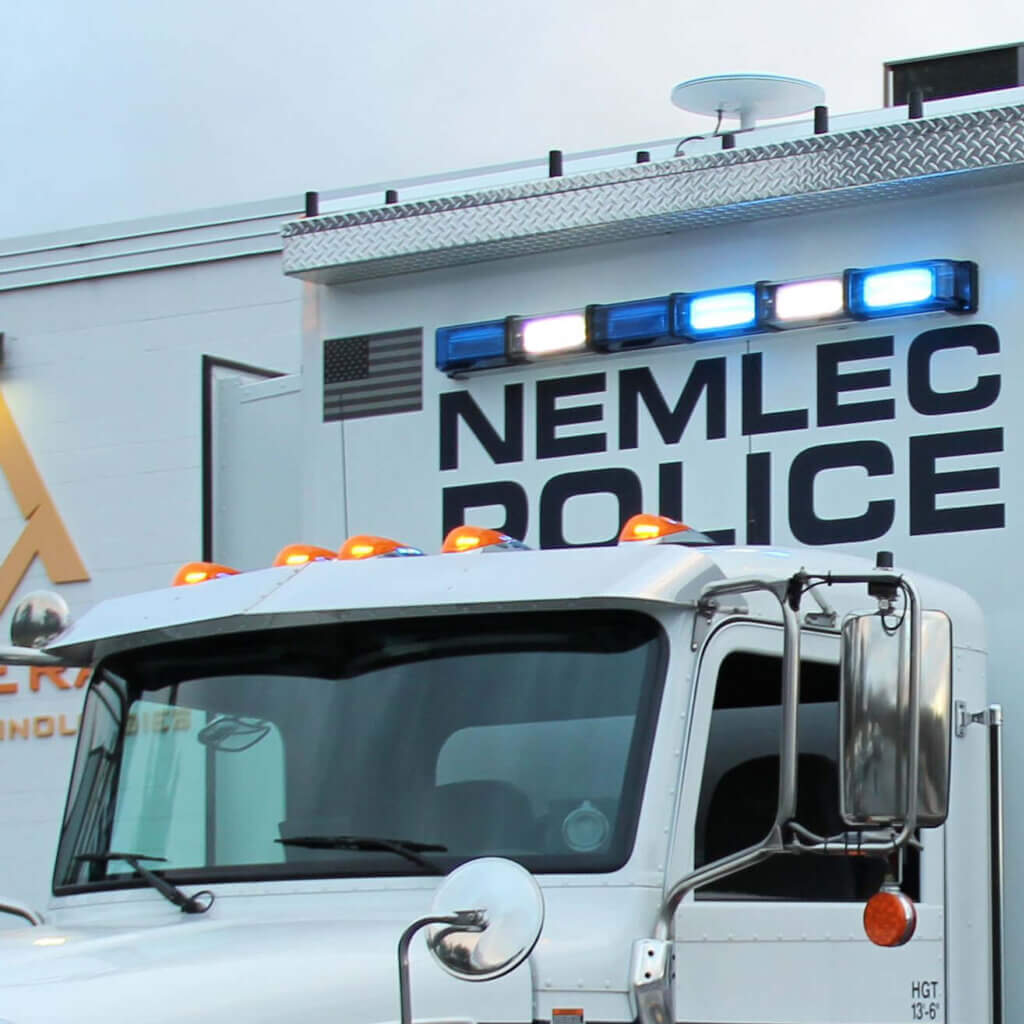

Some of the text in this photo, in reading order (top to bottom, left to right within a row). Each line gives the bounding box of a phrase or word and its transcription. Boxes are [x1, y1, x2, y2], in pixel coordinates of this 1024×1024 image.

[439, 323, 1002, 471] NEMLEC
[442, 426, 1005, 548] POLICE
[911, 980, 939, 999] HGT
